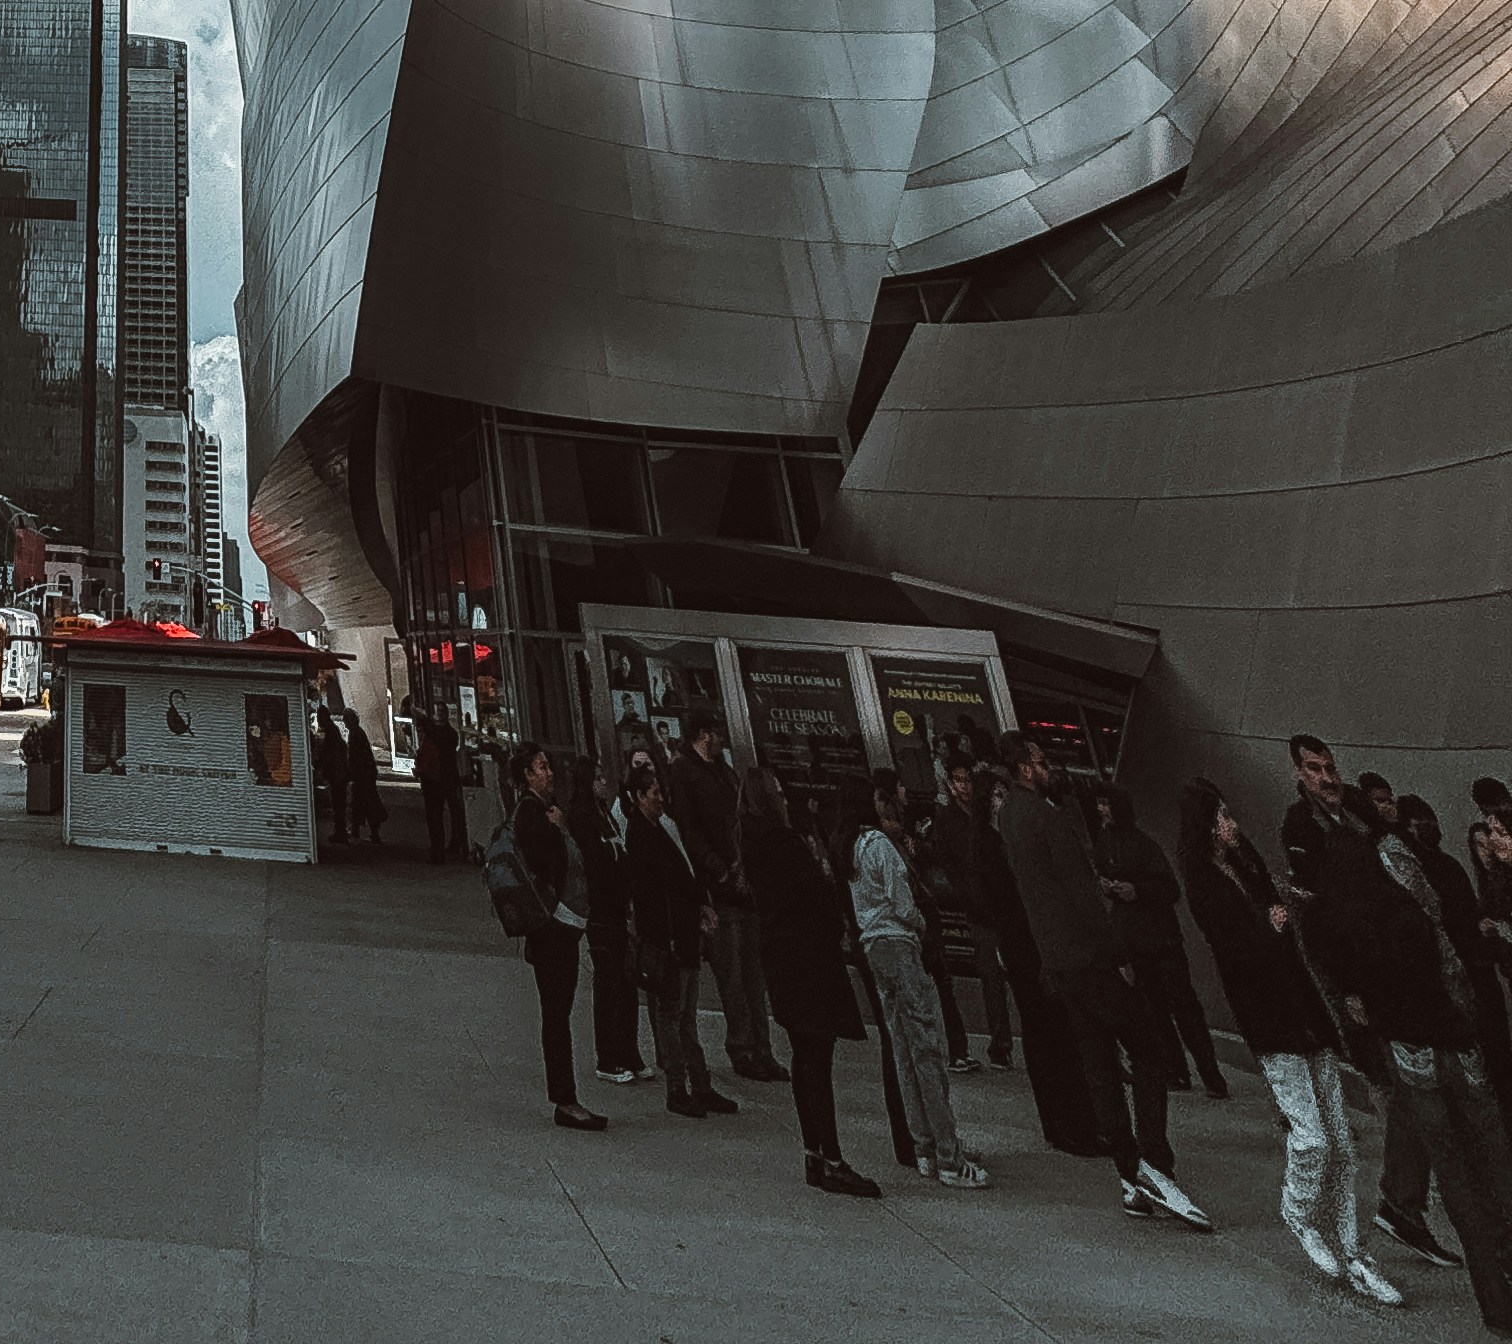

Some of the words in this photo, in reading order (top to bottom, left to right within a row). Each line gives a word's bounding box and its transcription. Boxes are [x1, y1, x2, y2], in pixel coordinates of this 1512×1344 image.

[749, 672, 793, 685] MASTER
[793, 675, 844, 688] CHORALE
[888, 686, 922, 701] ANNA
[922, 689, 985, 705] KARENINA
[770, 707, 836, 724] CELEBRATE
[768, 720, 792, 734] THE
